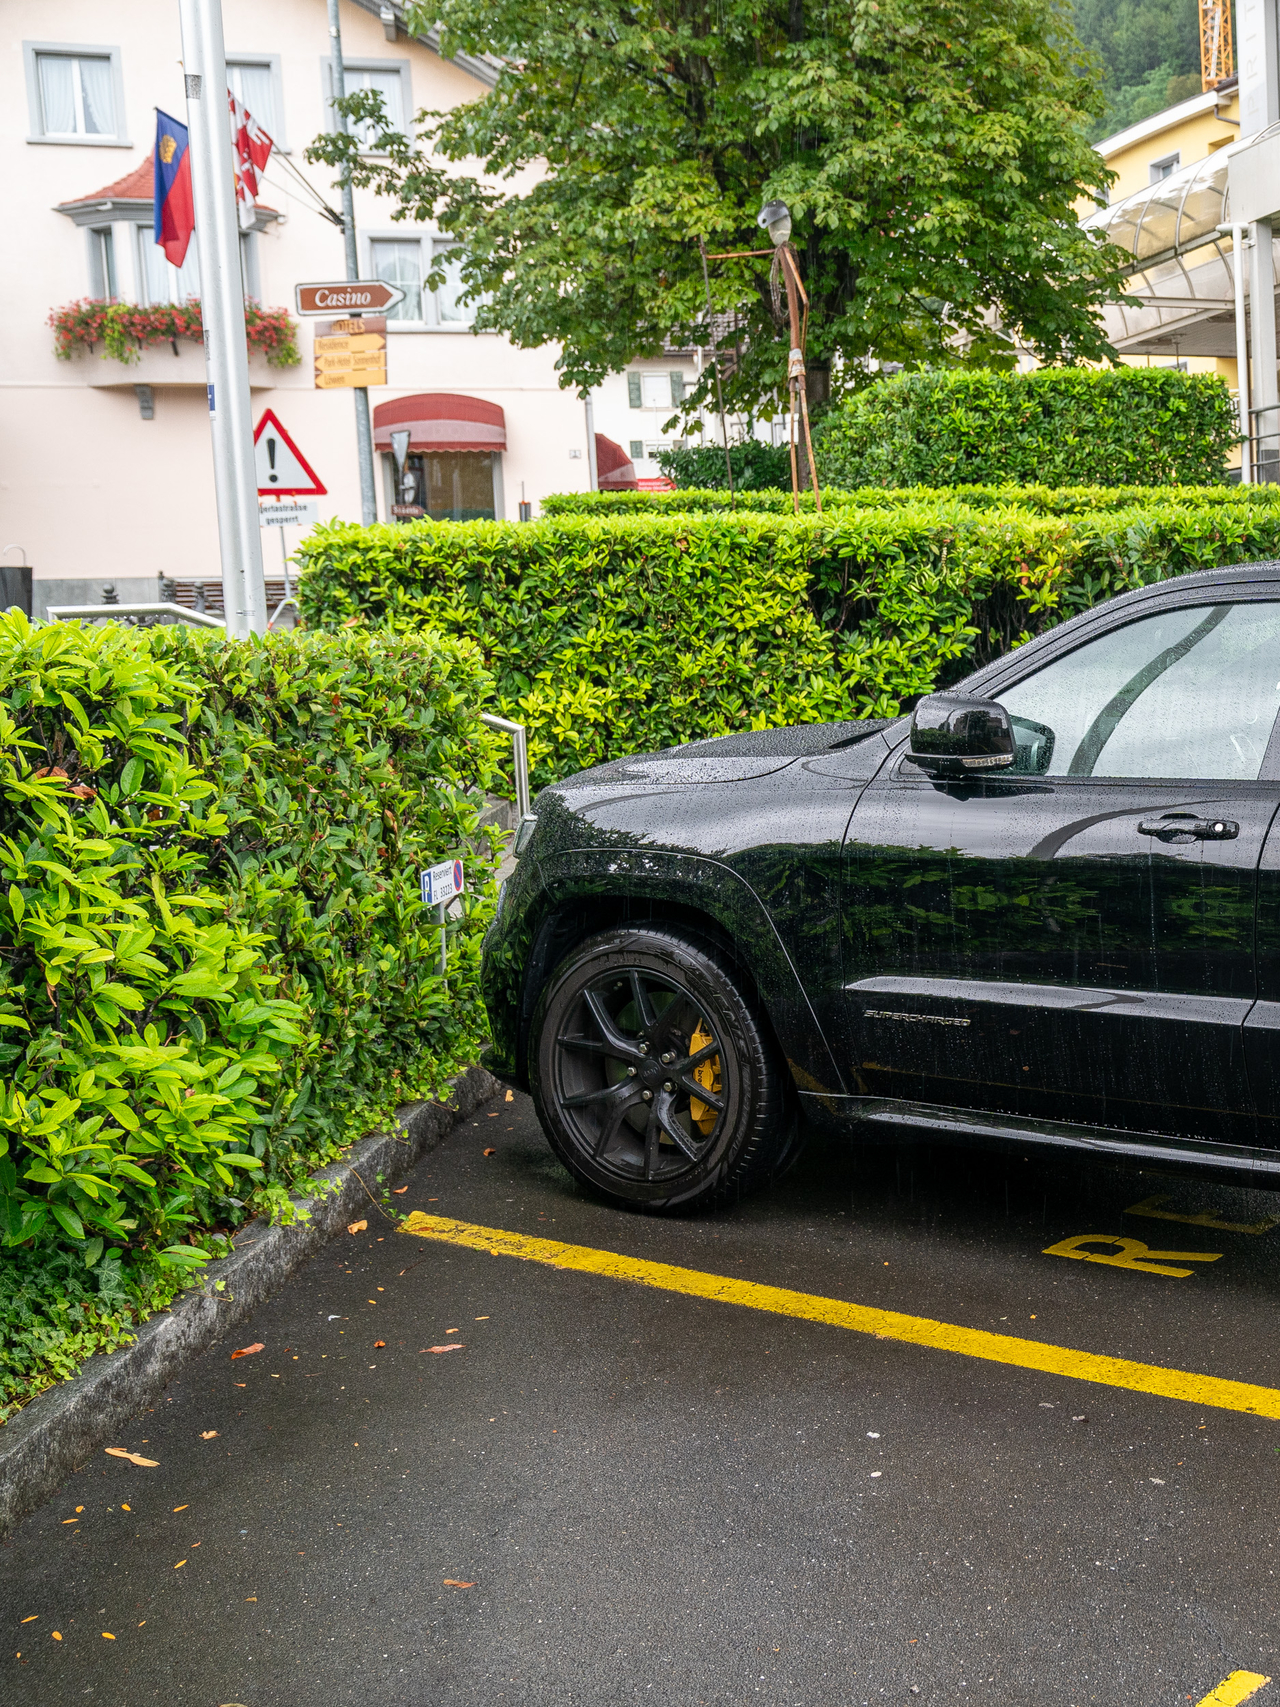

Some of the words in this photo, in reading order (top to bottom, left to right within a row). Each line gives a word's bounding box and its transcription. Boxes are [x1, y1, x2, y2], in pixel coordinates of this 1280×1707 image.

[315, 288, 371, 307] Casino
[432, 866, 452, 881] Reserviert
[863, 1009, 972, 1027] SUPERCHARGED
